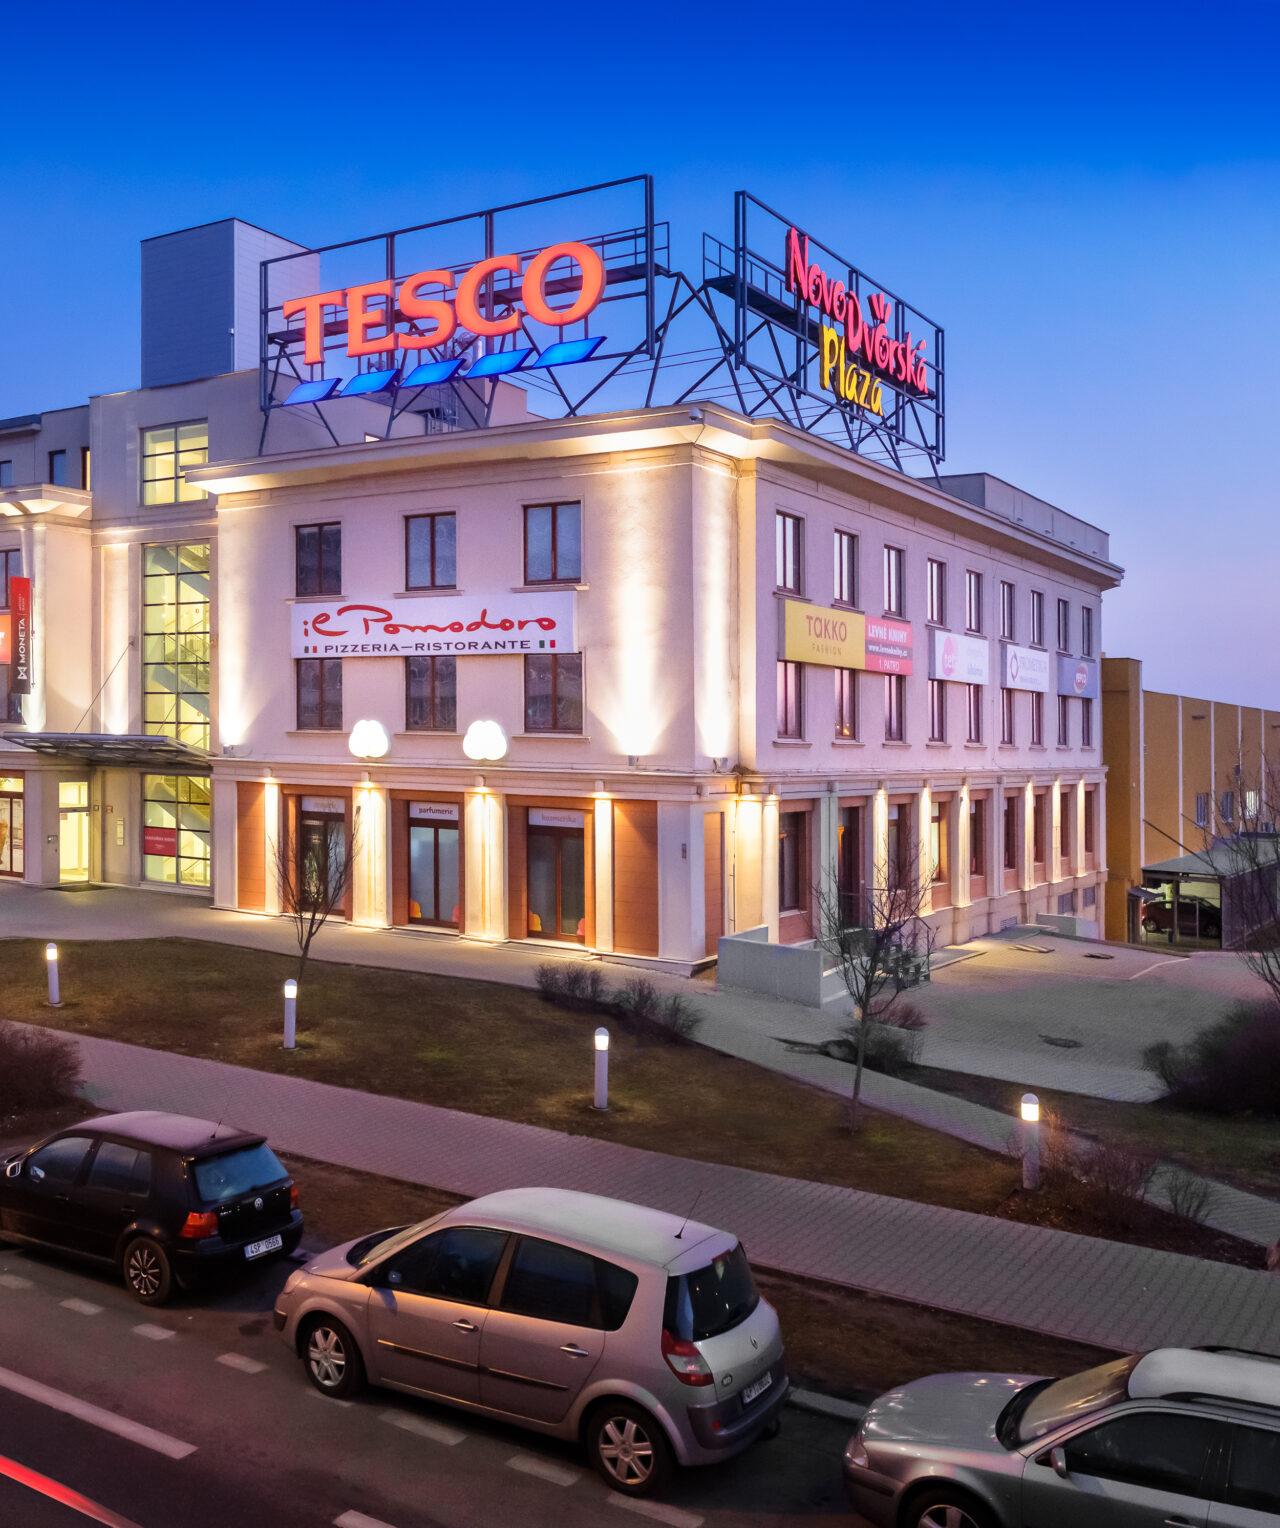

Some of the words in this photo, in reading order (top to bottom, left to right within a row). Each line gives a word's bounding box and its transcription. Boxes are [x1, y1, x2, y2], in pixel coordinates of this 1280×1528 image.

[283, 242, 606, 365] TESCO
[819, 324, 883, 416] Plaza
[337, 604, 556, 635] Pomodoro
[812, 643, 842, 656] FASHION
[419, 807, 454, 816] parfumerie
